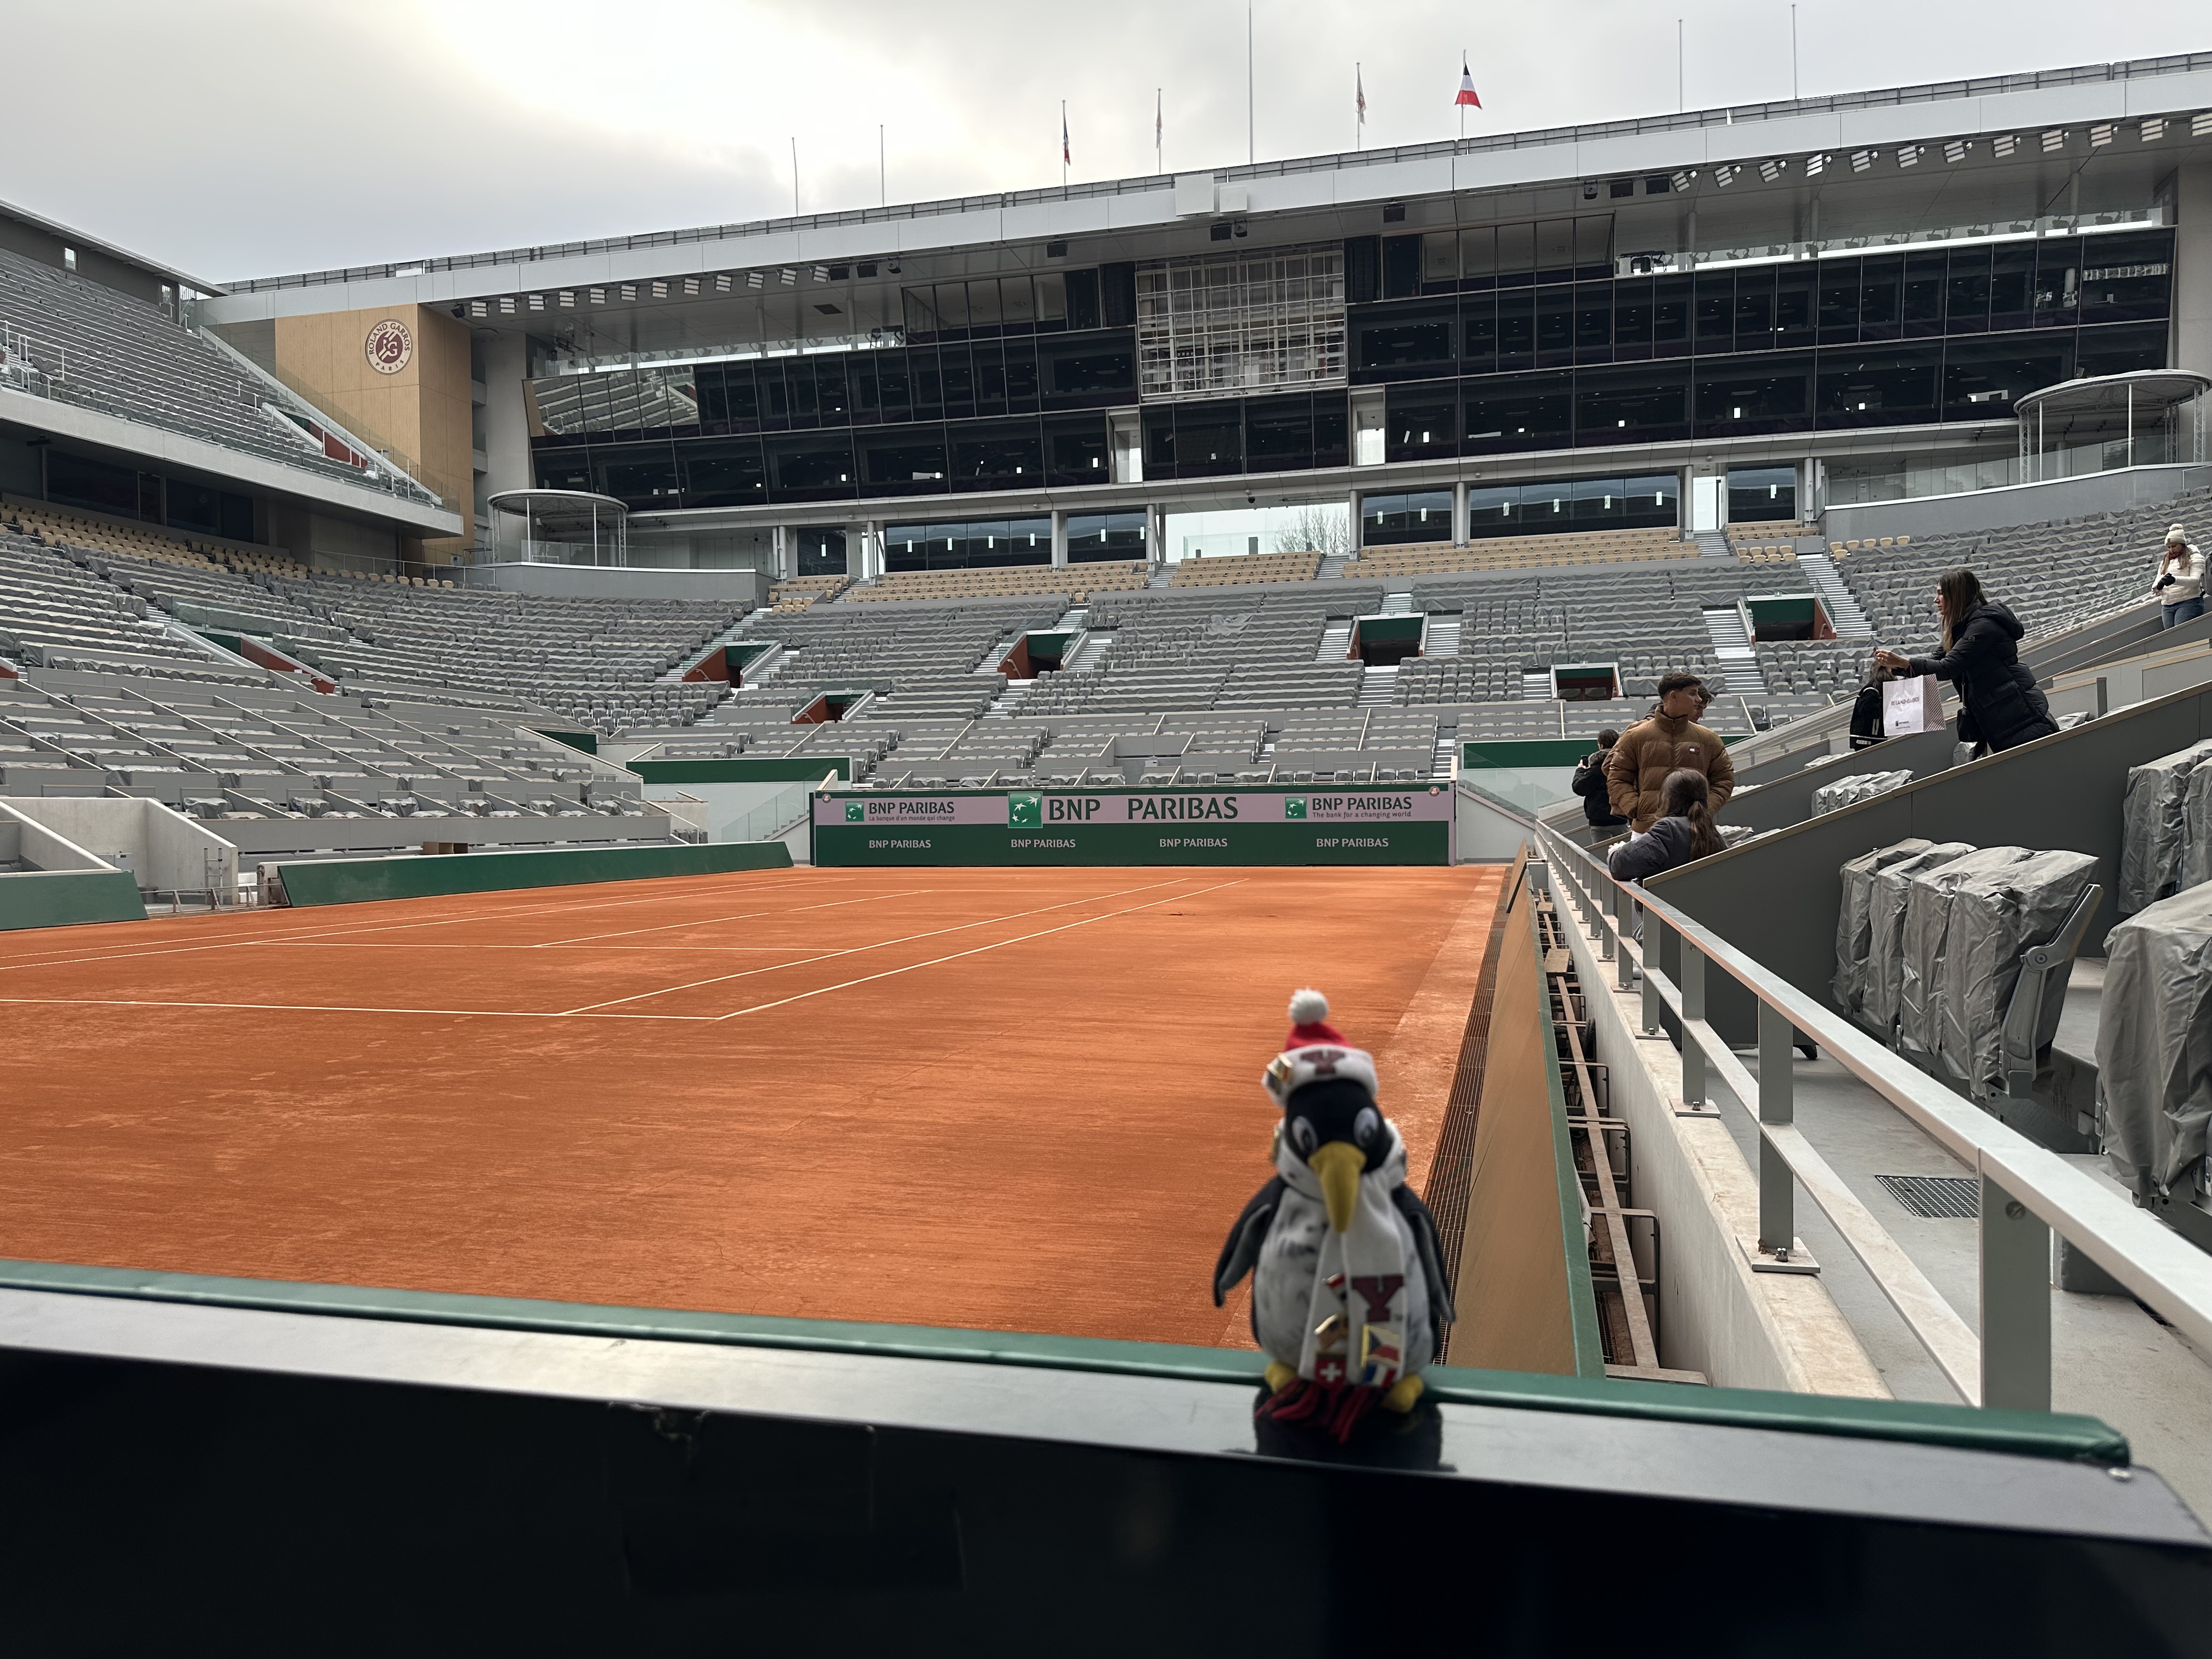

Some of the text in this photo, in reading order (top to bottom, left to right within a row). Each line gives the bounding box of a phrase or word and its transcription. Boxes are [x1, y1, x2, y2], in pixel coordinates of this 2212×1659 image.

[369, 323, 410, 354] ROLAND GARROS
[375, 359, 404, 371] PARIS
[868, 801, 955, 814] BNP PARIBAS
[1049, 797, 1238, 820] BNP PARIBAS
[1312, 797, 1412, 810] BNP PARIBAS
[868, 839, 932, 849] BNP PARIBAS
[1011, 839, 1076, 848] BNP PARIBAS
[1159, 838, 1228, 847] BNP PARIBAS
[1316, 838, 1389, 848] BNP PARIBAS
[1300, 1049, 1347, 1075] Y
[1351, 1273, 1404, 1322] Y
